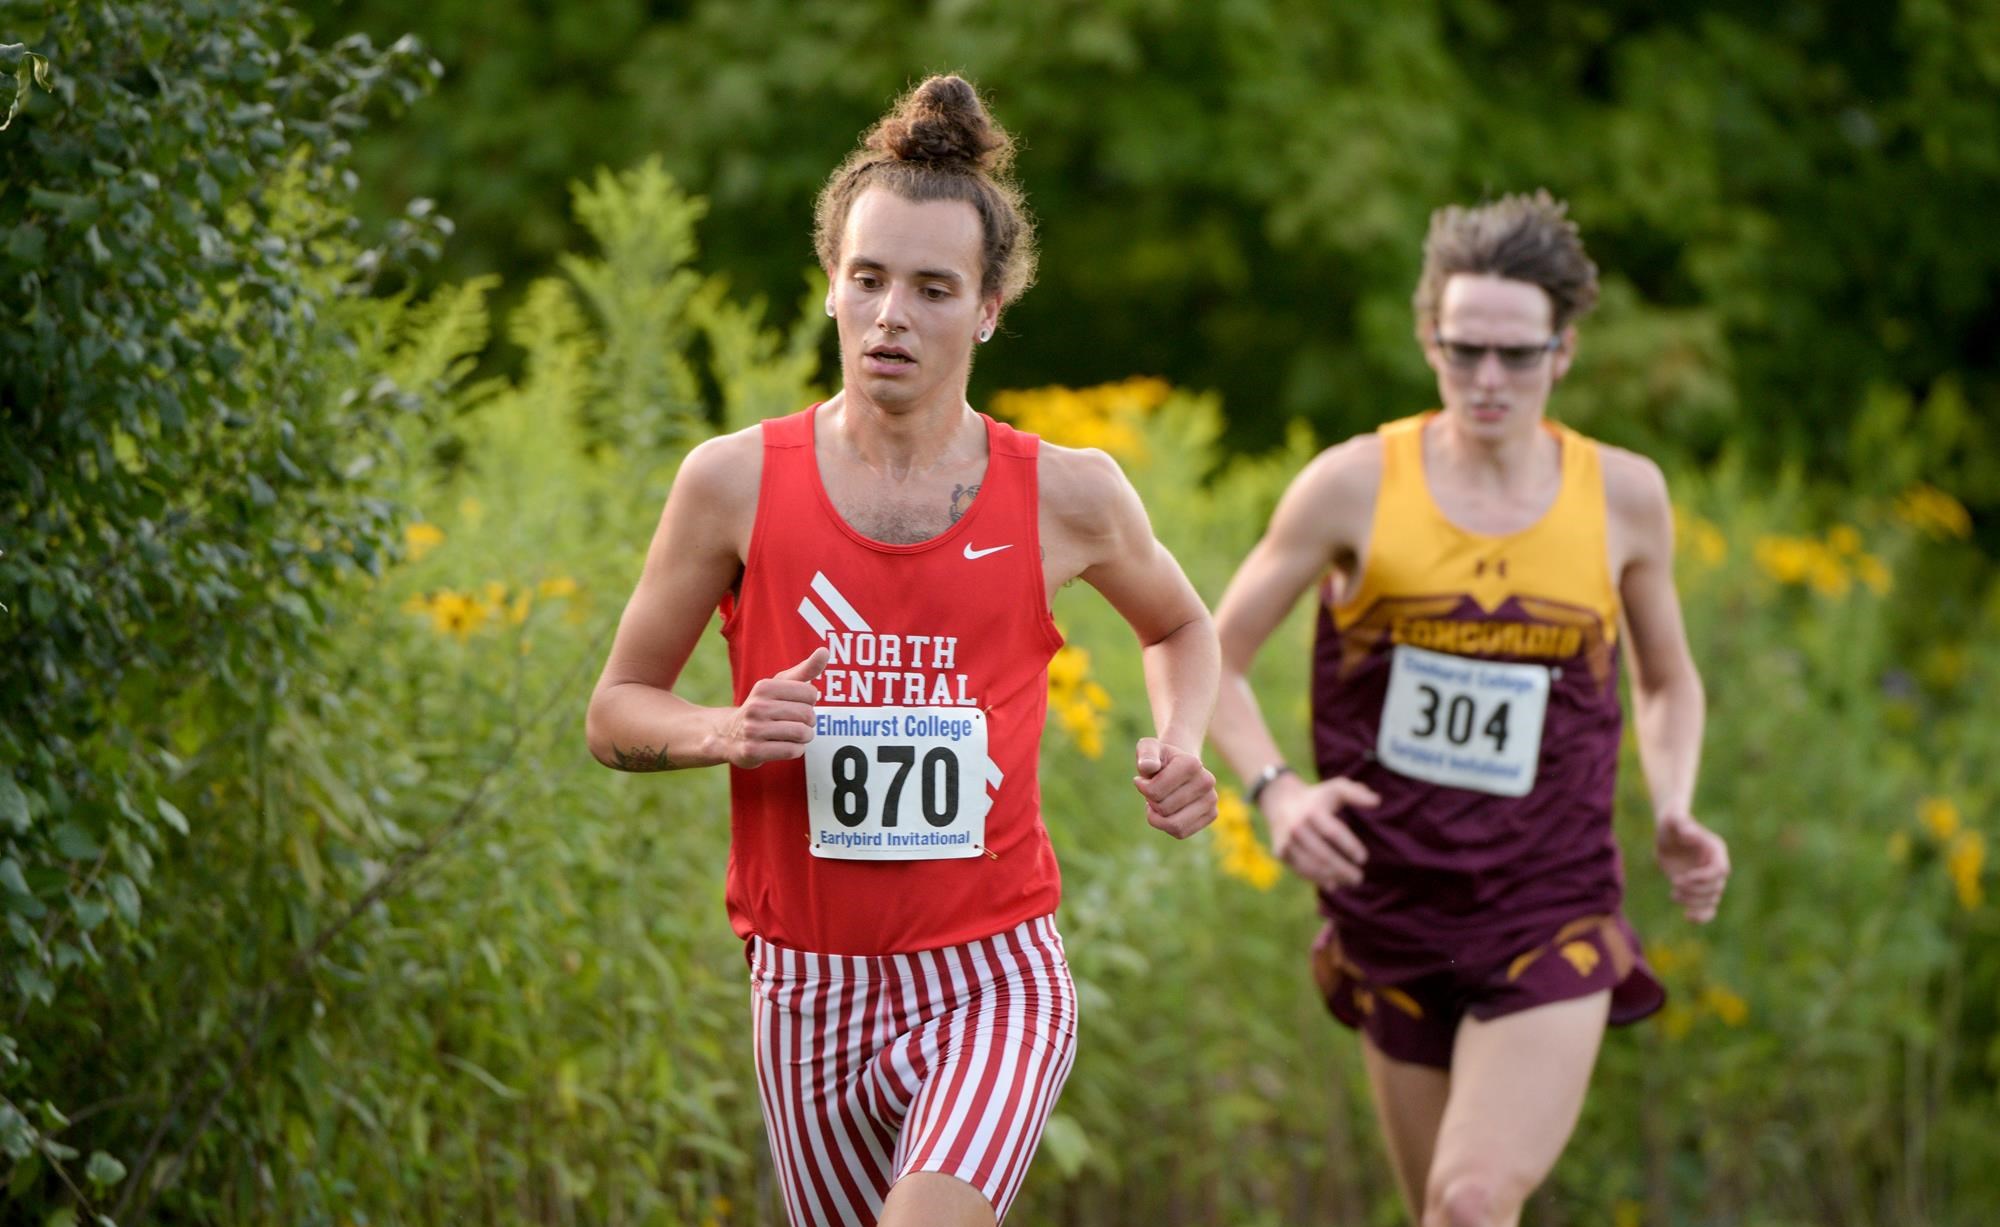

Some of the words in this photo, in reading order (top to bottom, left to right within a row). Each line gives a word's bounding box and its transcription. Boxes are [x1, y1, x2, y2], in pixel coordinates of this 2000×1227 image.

[827, 632, 957, 669] NORTH
[815, 669, 977, 705] ENTRAL
[816, 714, 898, 737] Elmhurst
[904, 715, 972, 741] College
[1411, 683, 1511, 753] 304
[832, 745, 959, 828] 870
[820, 830, 882, 848] Earlybird
[887, 830, 970, 846] Invitational
